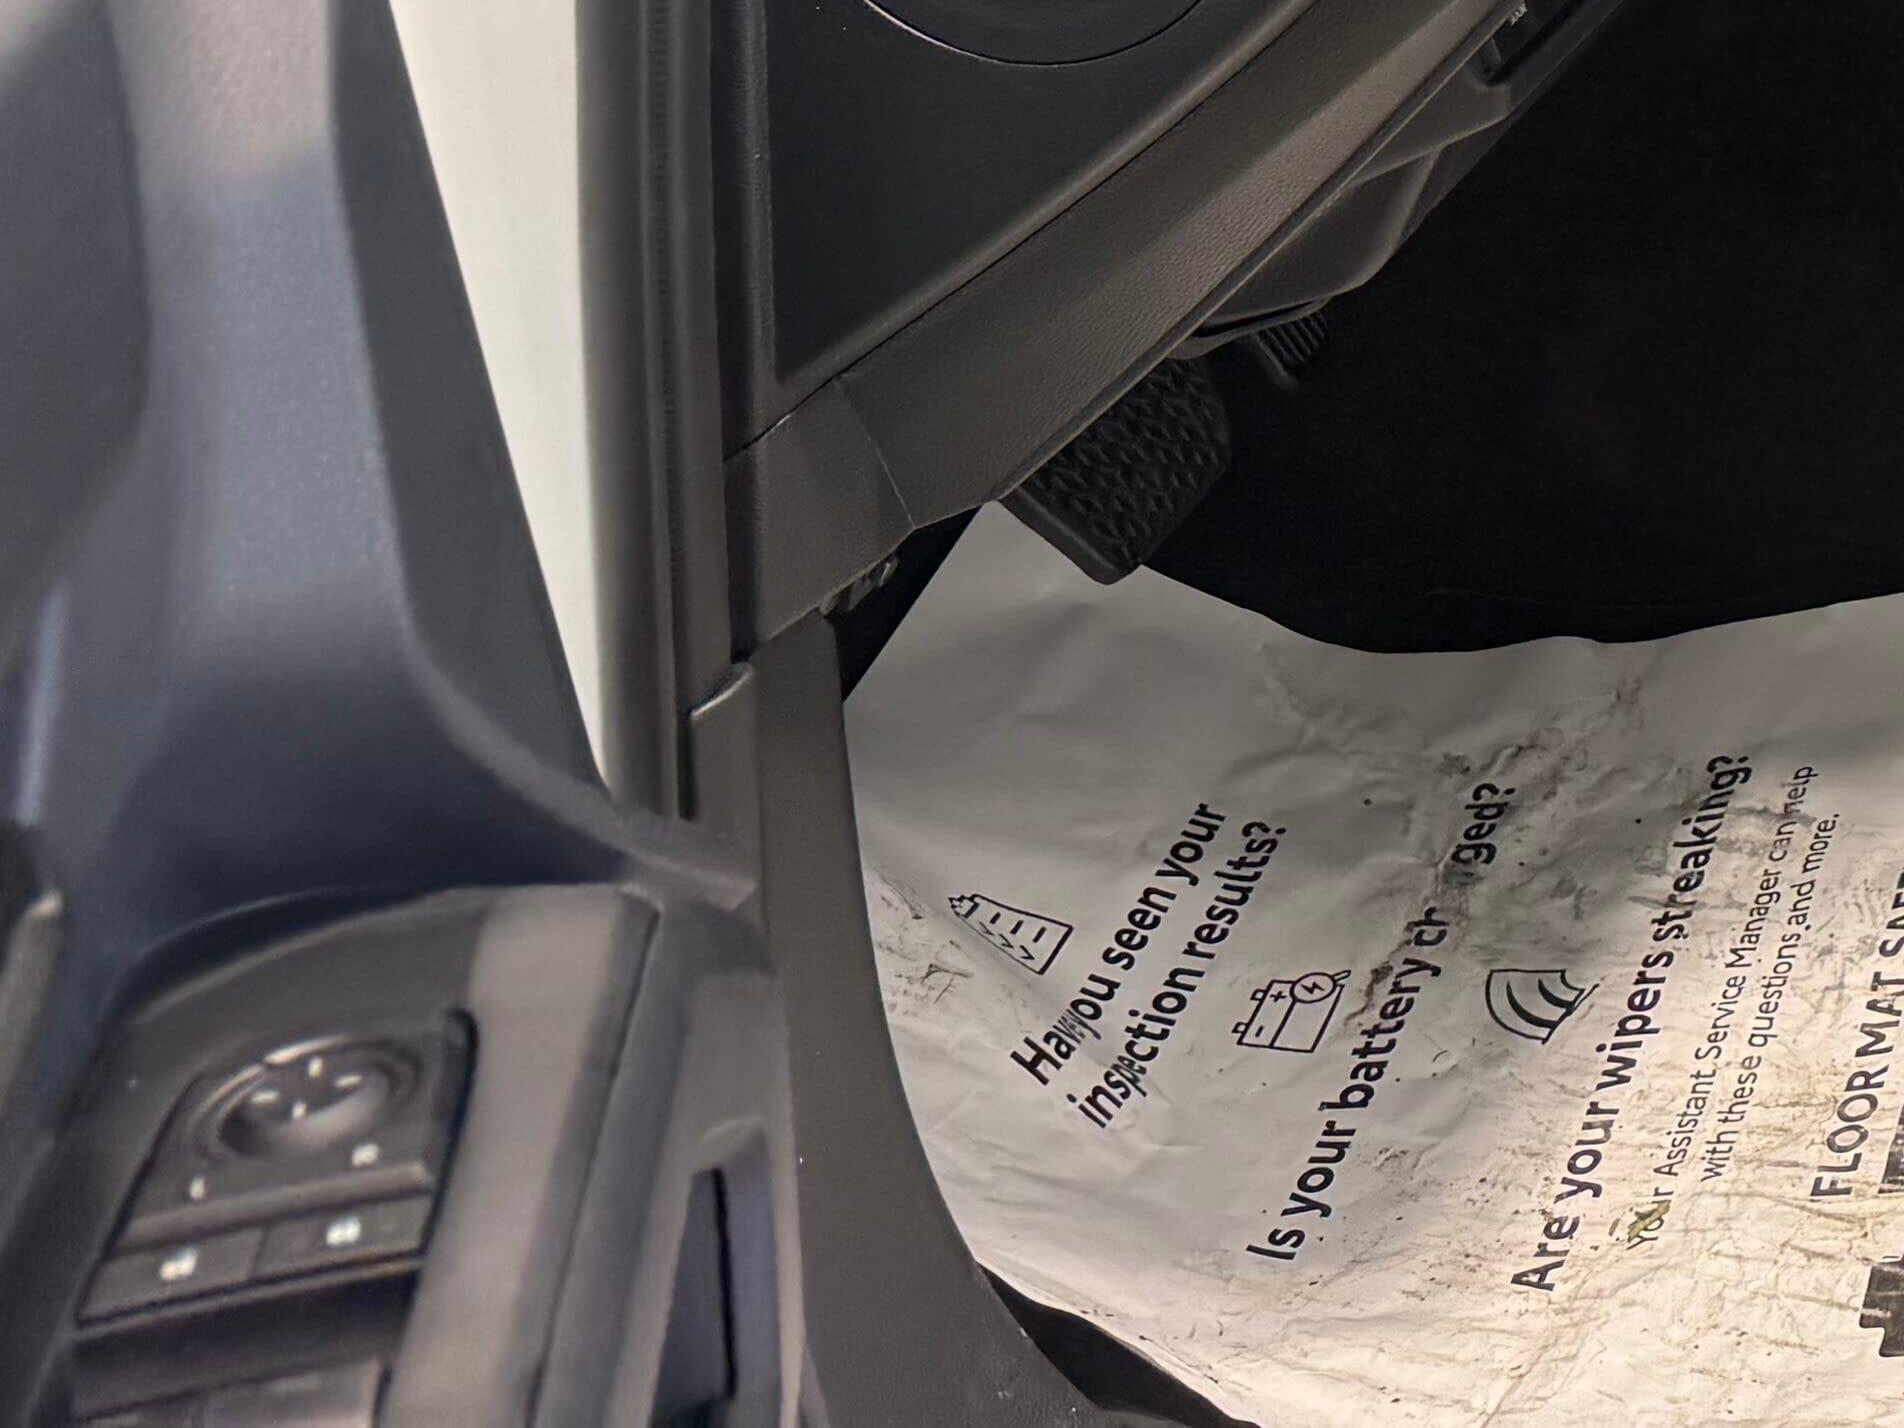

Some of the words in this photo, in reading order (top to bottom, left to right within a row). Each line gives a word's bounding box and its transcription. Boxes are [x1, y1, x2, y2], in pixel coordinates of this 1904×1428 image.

[1102, 887, 1177, 970] seen
[1155, 803, 1225, 886] your
[1790, 878, 1818, 930] and
[1802, 812, 1841, 874] more.
[1066, 967, 1205, 1128] inspection
[1182, 821, 1287, 959] results?
[1510, 1209, 1580, 1293] Are
[1560, 1101, 1621, 1198] your
[1596, 951, 1674, 1090] wipers
[1653, 754, 1751, 940] streaking?
[1653, 1074, 1717, 1177] Assistant
[1695, 975, 1748, 1061] Service
[1727, 862, 1782, 966] Manager
[1769, 821, 1797, 863] can
[1747, 932, 1802, 1048] questions
[1246, 1230, 1306, 1261] Is
[1281, 1120, 1357, 1218] your
[1320, 957, 1442, 1110] battery
[1701, 1126, 1737, 1183] with
[1718, 1054, 1763, 1121] these
[1811, 1063, 1890, 1200] FLOOR
